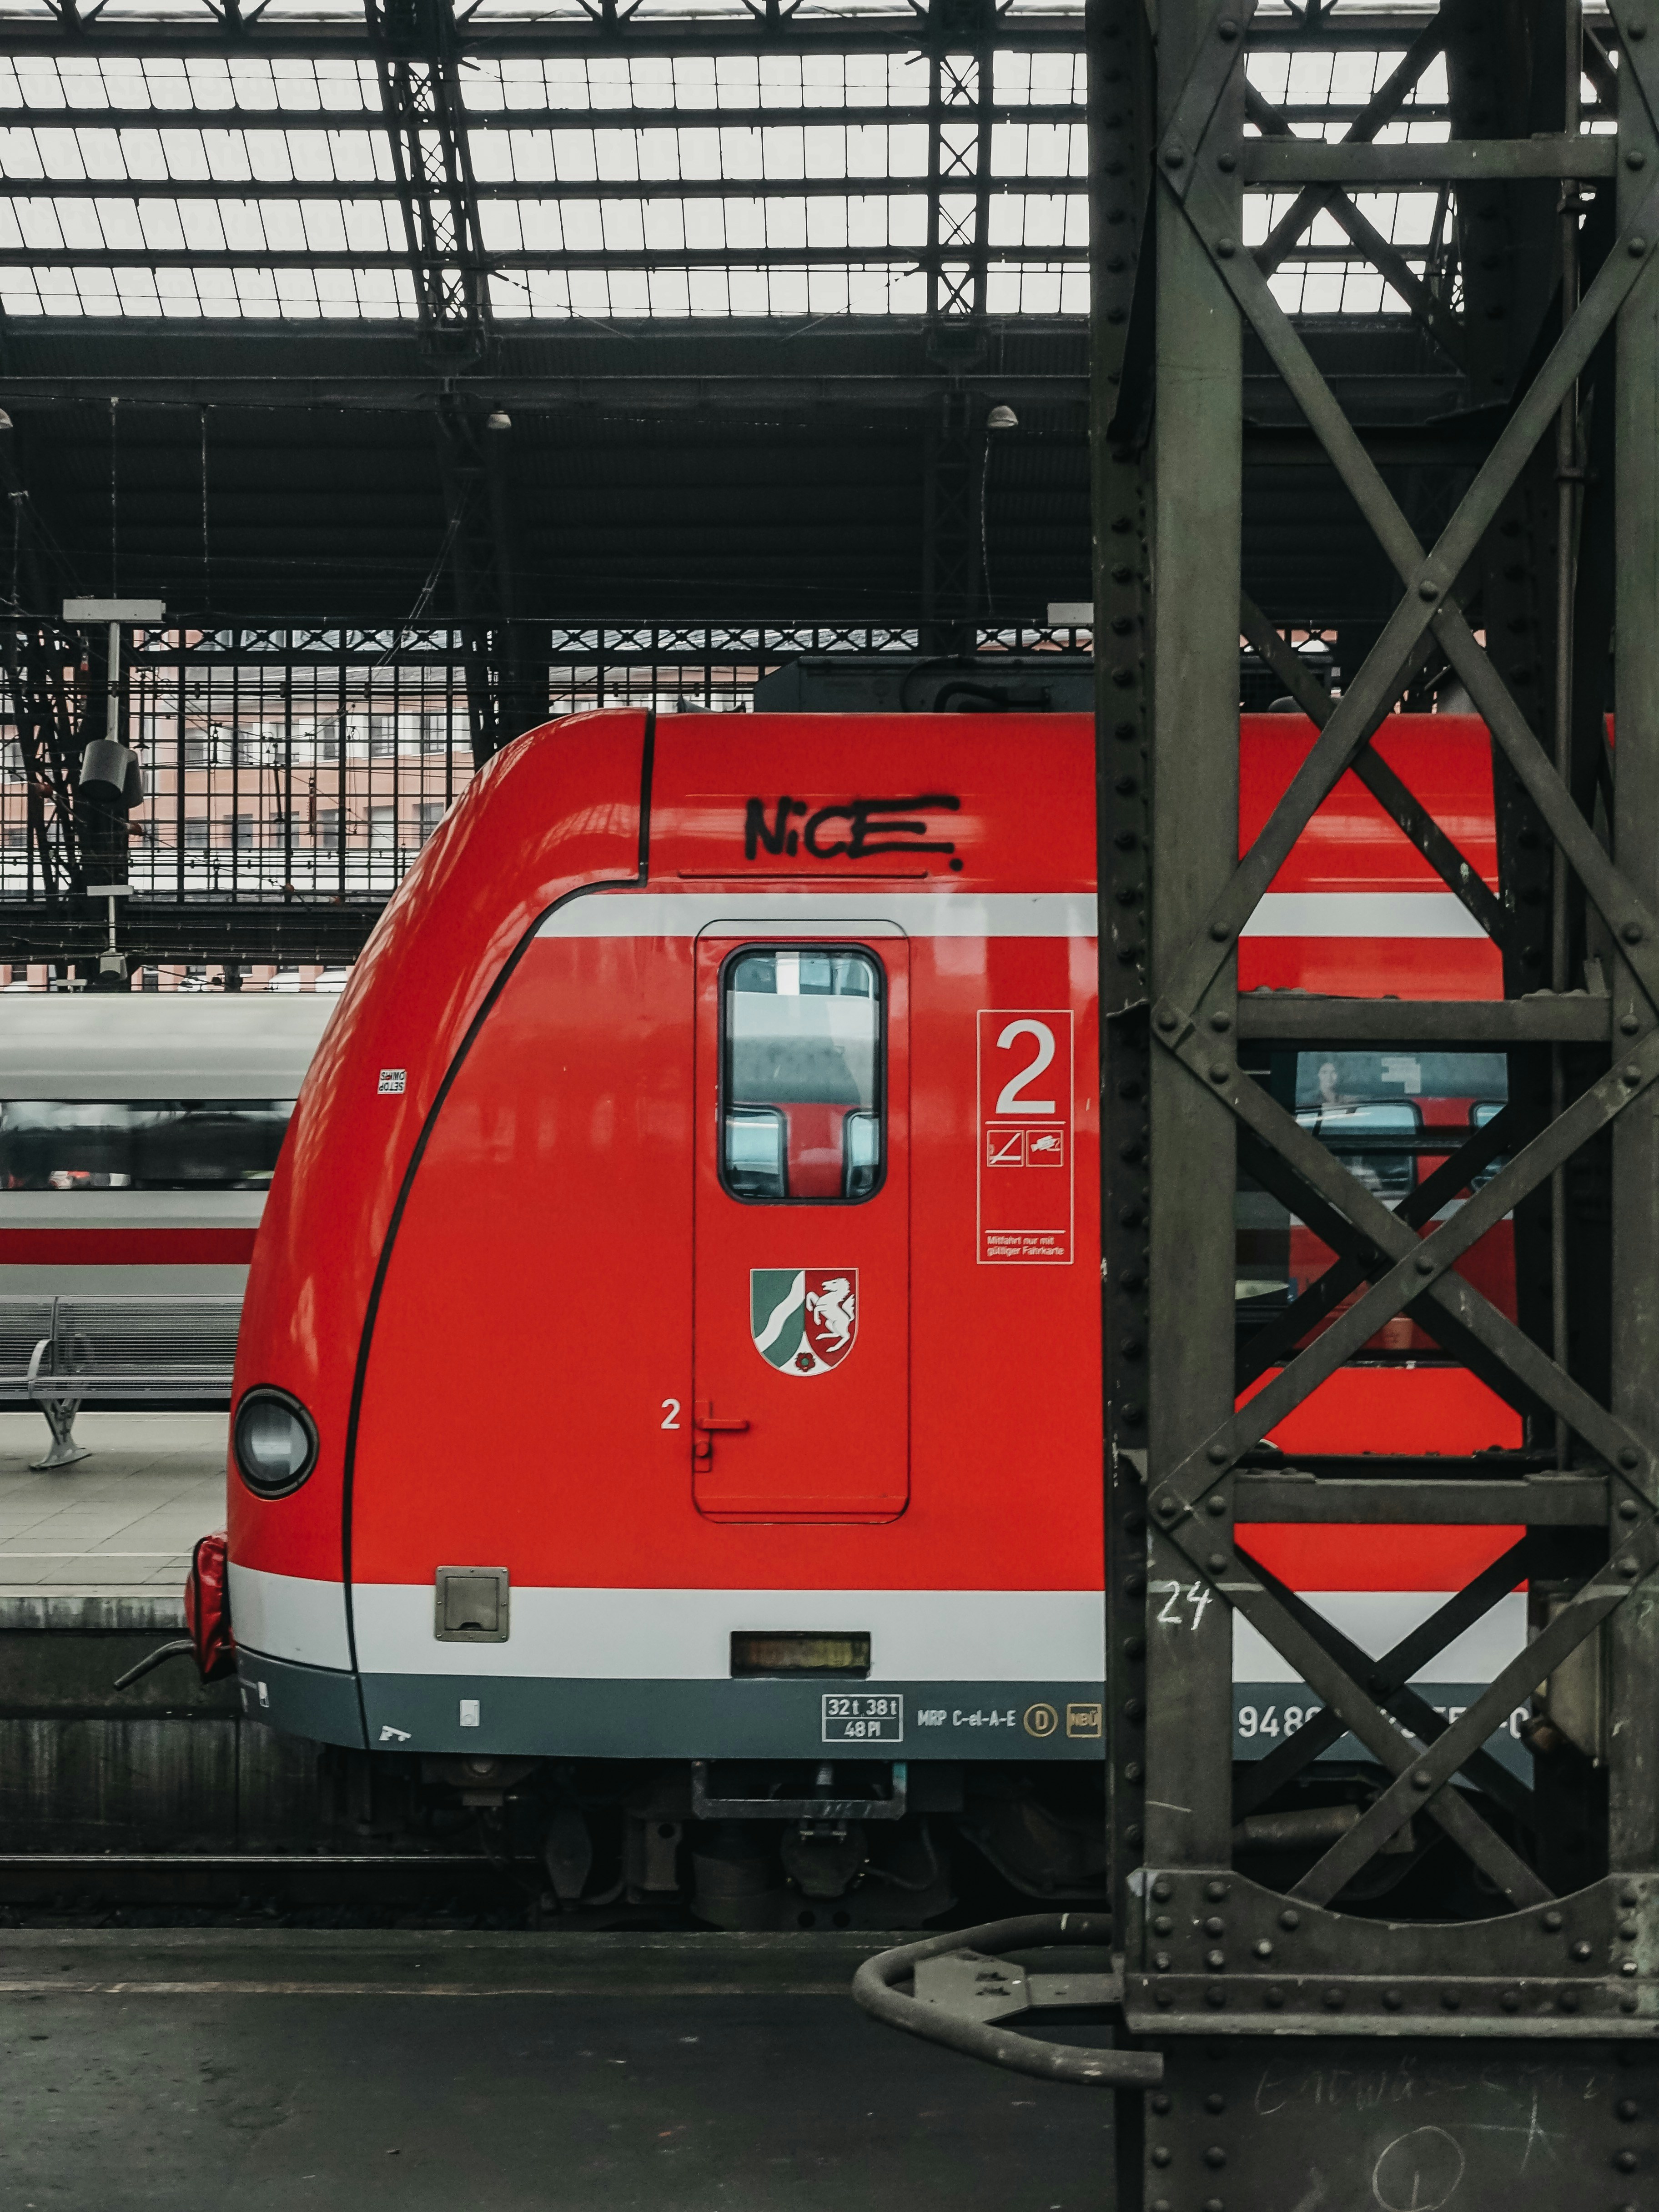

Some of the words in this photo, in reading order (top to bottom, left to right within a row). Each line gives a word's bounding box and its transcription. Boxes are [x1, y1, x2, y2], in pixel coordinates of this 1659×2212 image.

[995, 1019, 1056, 1114] 2
[987, 1236, 1021, 1245] Mitfahrt
[1040, 1236, 1054, 1245] mit
[1022, 1246, 1064, 1255] Fahrkarte
[661, 1398, 681, 1429] 2
[1156, 1580, 1214, 1631] 24
